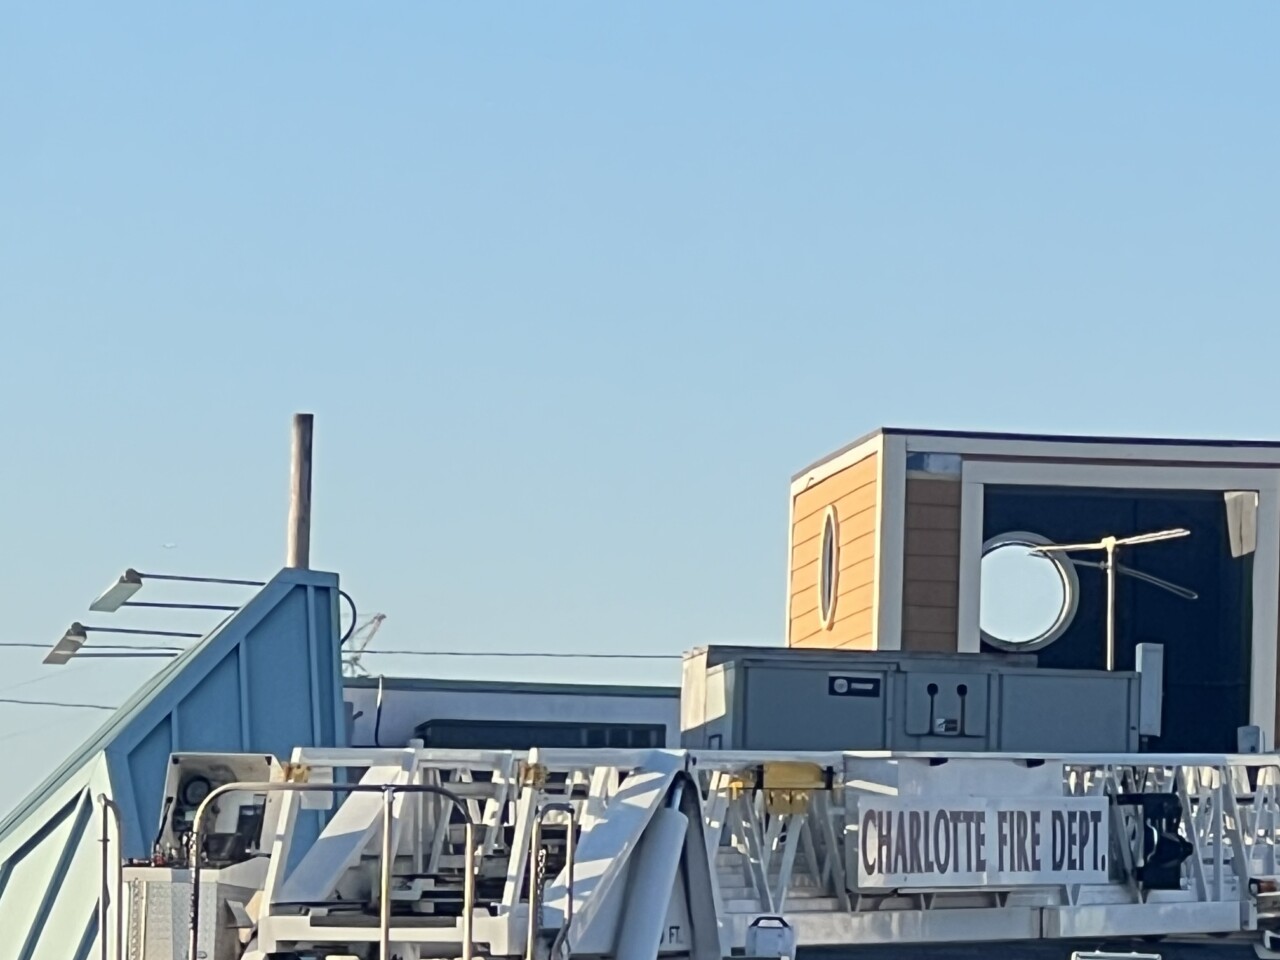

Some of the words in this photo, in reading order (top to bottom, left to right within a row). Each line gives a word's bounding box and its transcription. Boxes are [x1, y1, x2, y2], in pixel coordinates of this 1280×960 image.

[861, 808, 987, 876] CHARLOTTE
[997, 810, 1042, 872] FIRE
[1052, 810, 1106, 871] DEPT.
